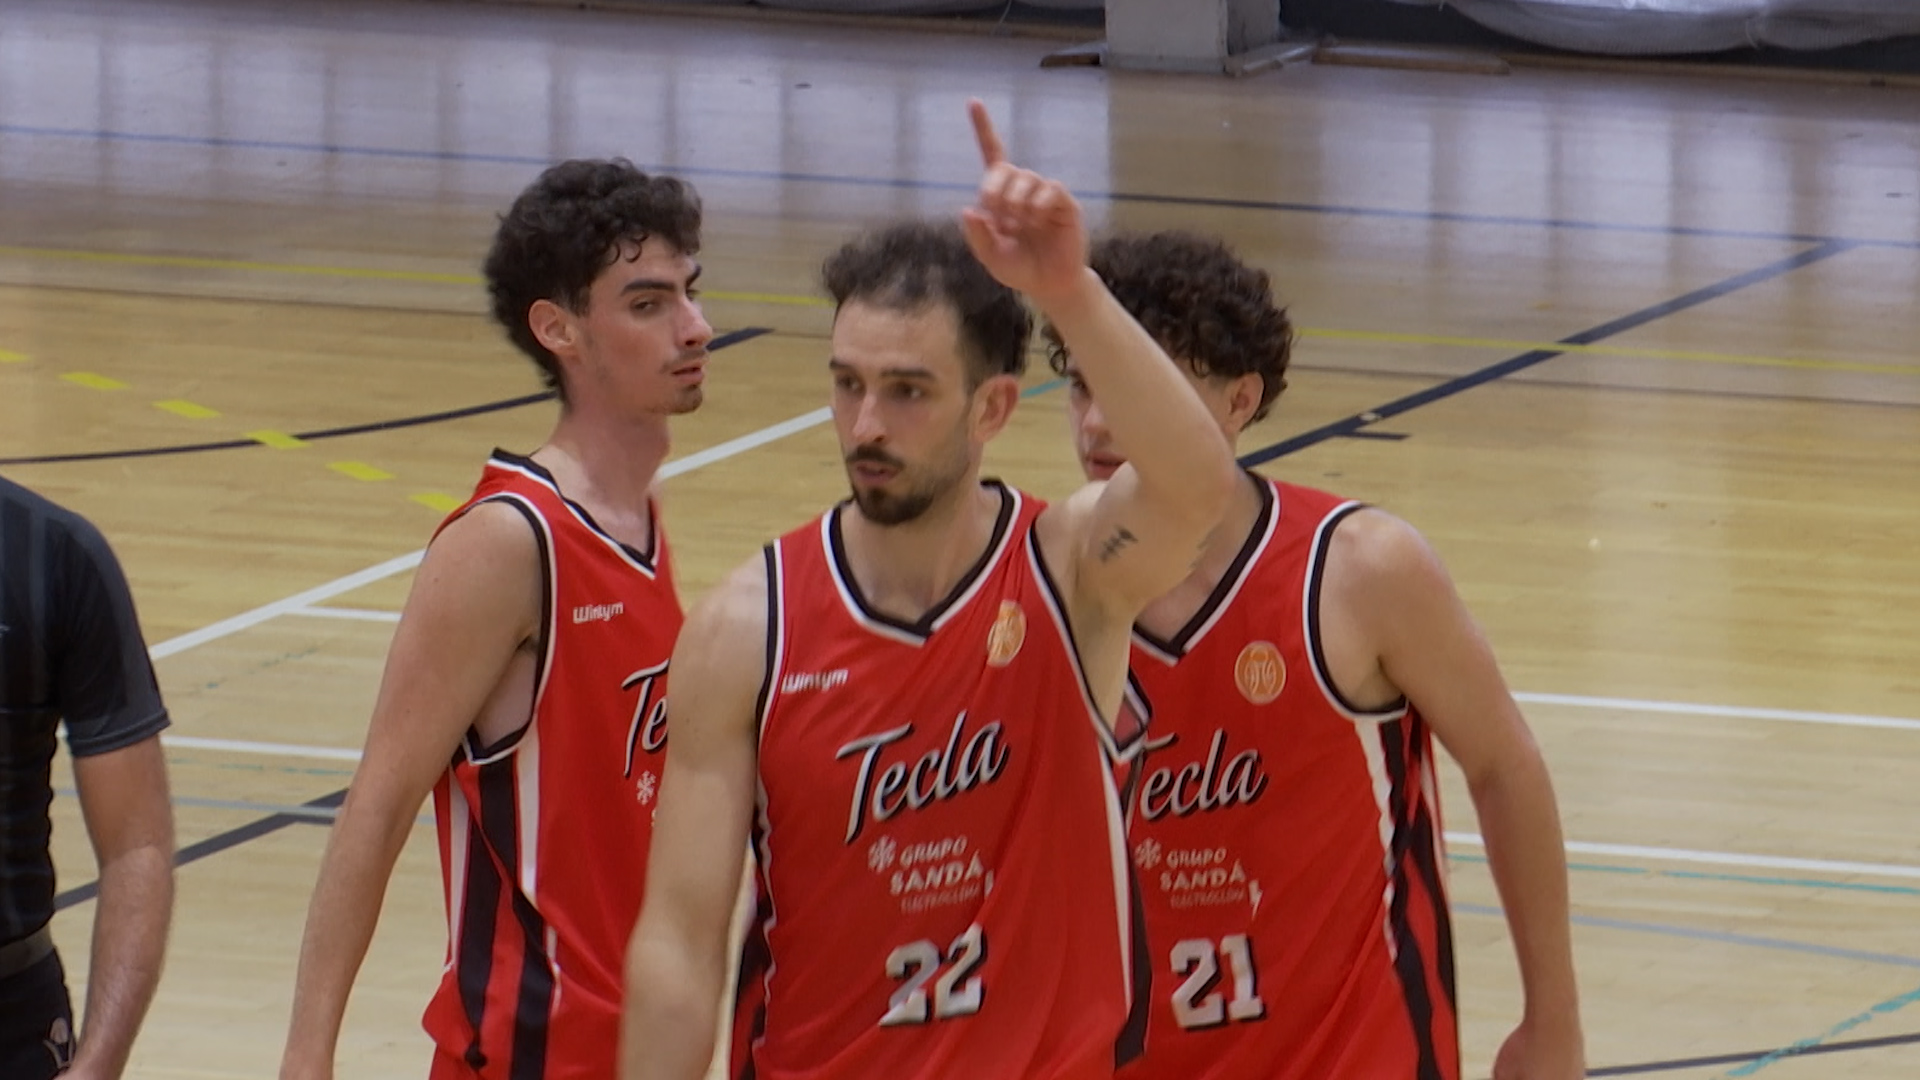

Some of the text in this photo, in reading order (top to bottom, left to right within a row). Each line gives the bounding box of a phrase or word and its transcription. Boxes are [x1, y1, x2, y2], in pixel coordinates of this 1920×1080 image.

[835, 709, 1011, 845] Tecla
[900, 835, 968, 869] GRUPO
[1166, 847, 1227, 868] GRUPO
[878, 921, 988, 1026] 22
[1169, 932, 1267, 1030] 21
